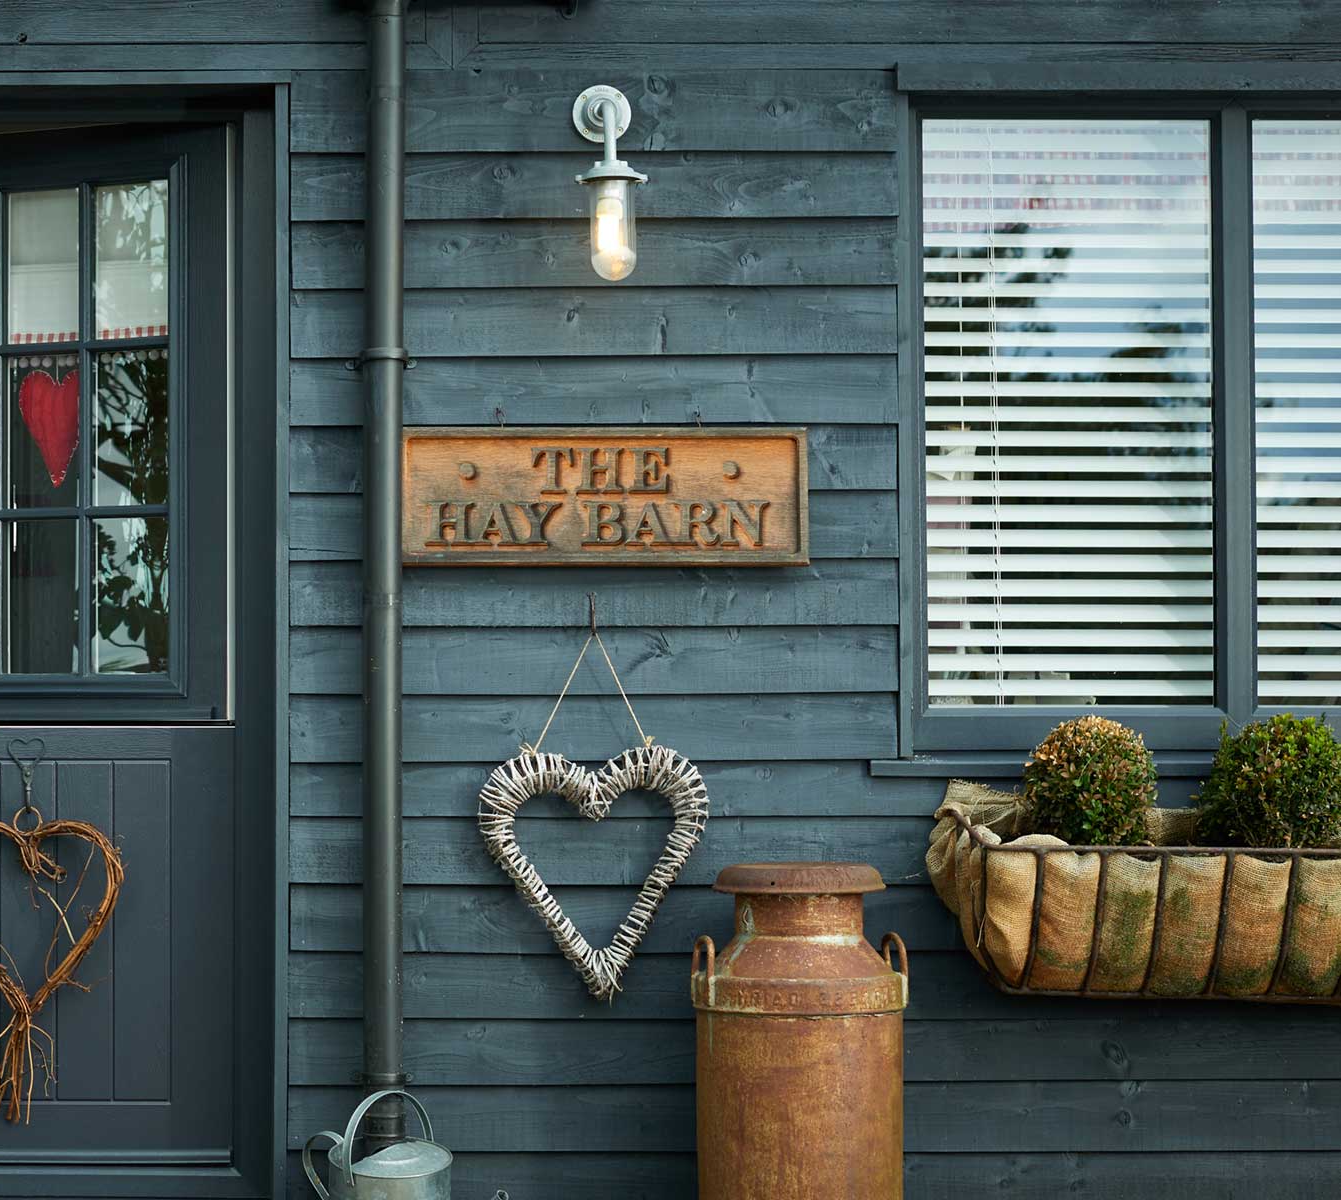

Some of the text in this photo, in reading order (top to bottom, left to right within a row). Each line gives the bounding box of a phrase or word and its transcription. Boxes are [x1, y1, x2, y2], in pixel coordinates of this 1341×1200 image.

[531, 447, 670, 495] THE
[424, 500, 771, 547] HAY BARN
